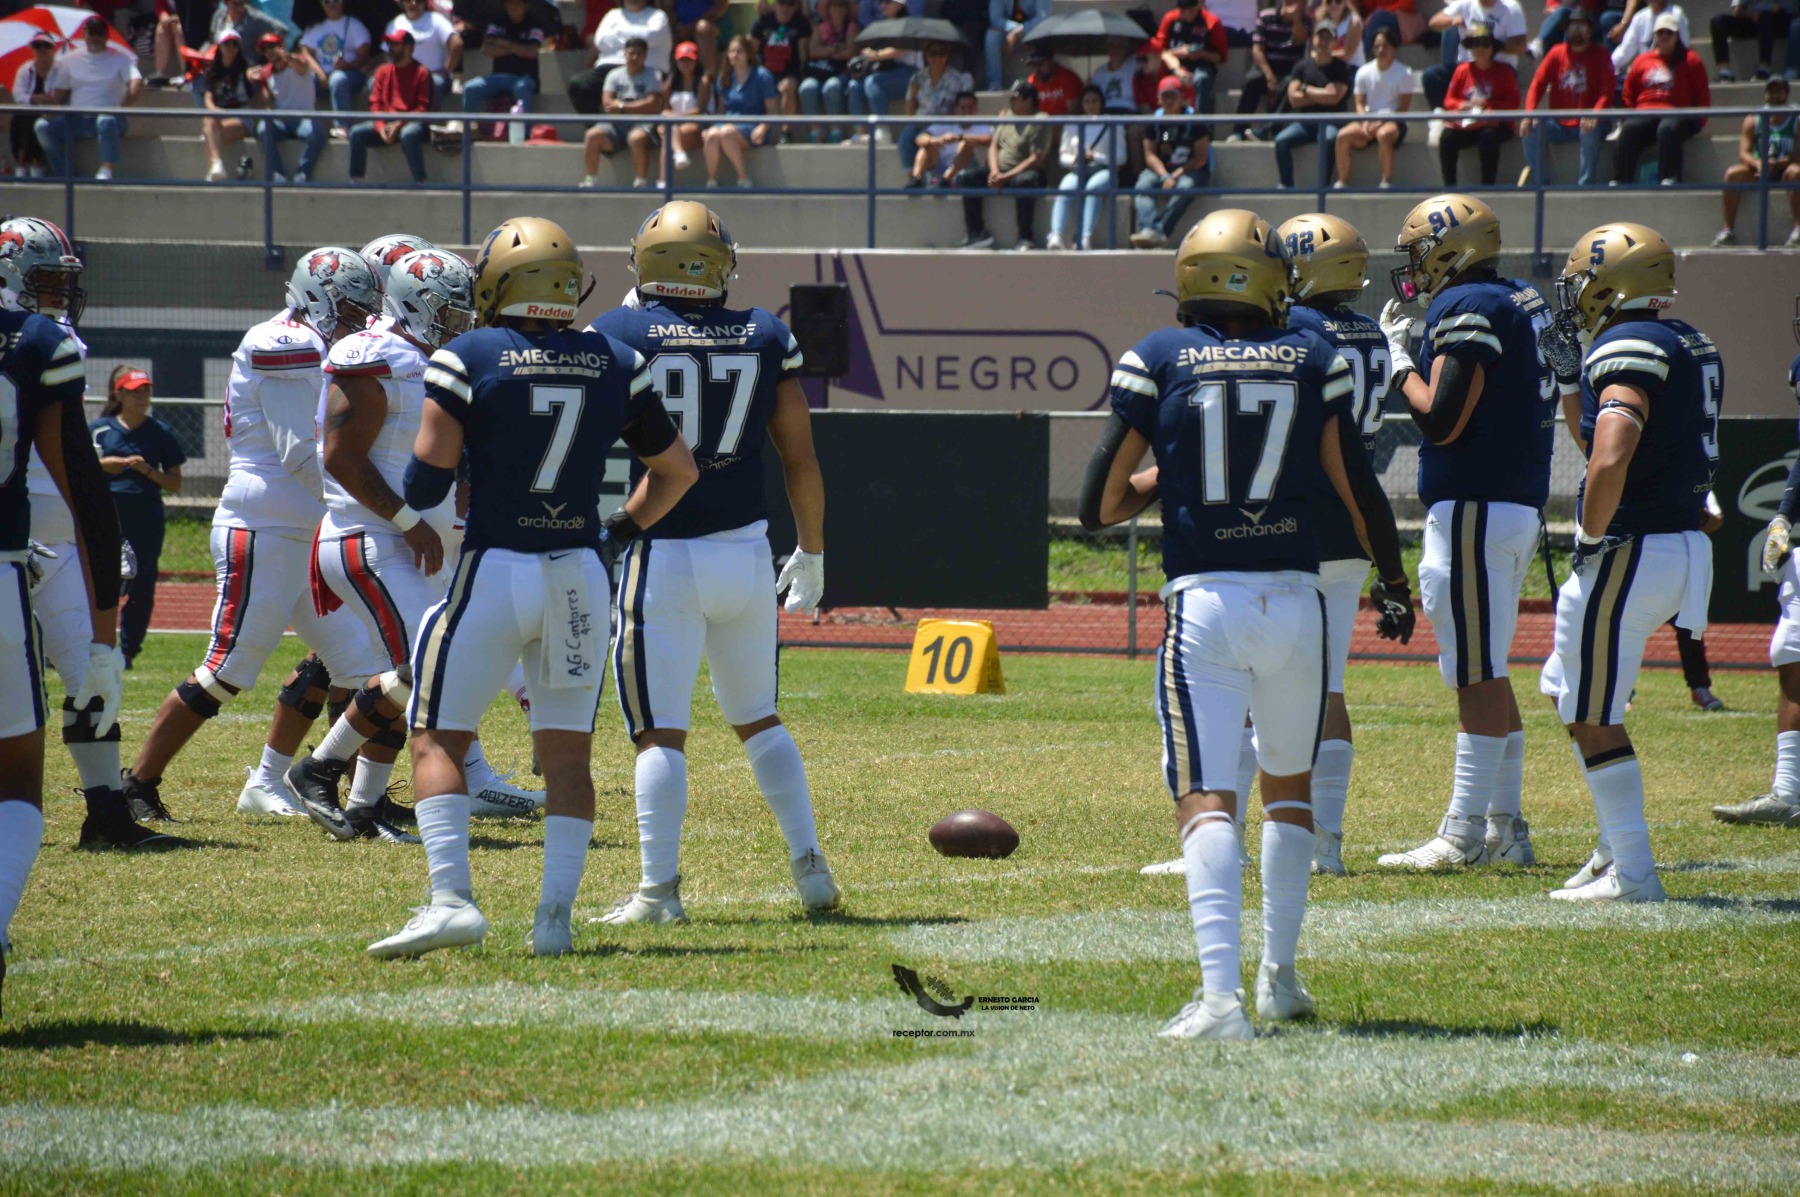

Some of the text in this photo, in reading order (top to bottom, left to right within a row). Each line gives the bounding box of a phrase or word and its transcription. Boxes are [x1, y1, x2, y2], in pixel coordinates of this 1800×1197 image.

[1428, 206, 1460, 234] 91
[1284, 230, 1315, 258] 92
[1590, 239, 1607, 266] 5
[656, 284, 707, 297] Riddell
[527, 304, 575, 319] Riddell
[656, 324, 747, 338] MECANO
[508, 348, 601, 369] MECANO
[1188, 344, 1298, 364] MECANO
[896, 355, 1080, 391] NEGRO
[647, 352, 761, 456] 97
[529, 382, 586, 493] 7
[1188, 379, 1299, 506] 17
[564, 588, 582, 650] Cantares
[922, 635, 974, 685] 10
